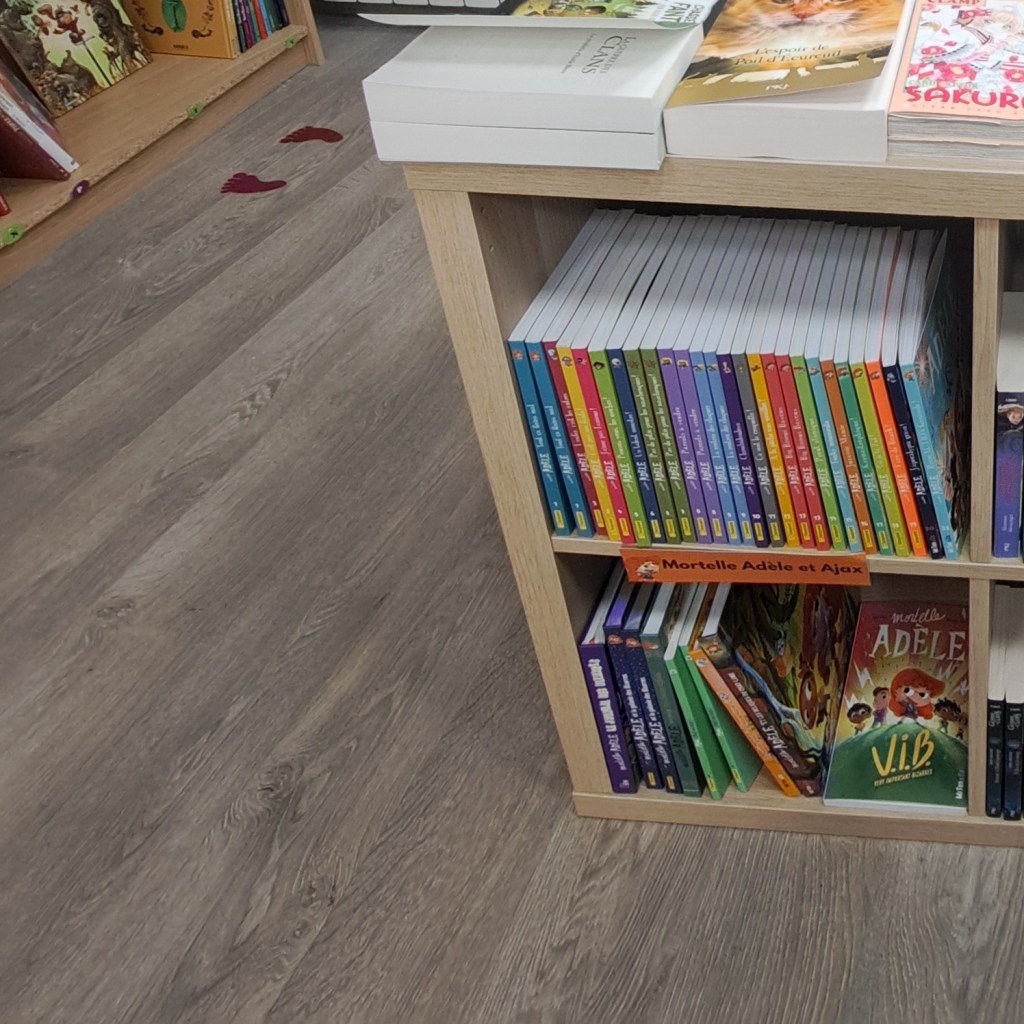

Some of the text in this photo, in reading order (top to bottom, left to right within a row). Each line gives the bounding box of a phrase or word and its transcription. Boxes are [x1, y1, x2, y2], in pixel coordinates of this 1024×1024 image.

[581, 35, 623, 74] CLANS
[754, 46, 807, 55] L'espoir
[735, 56, 766, 65] Poil
[662, 558, 863, 575] Mortelle Adèle et Ajax
[869, 622, 966, 662] ADÈLE
